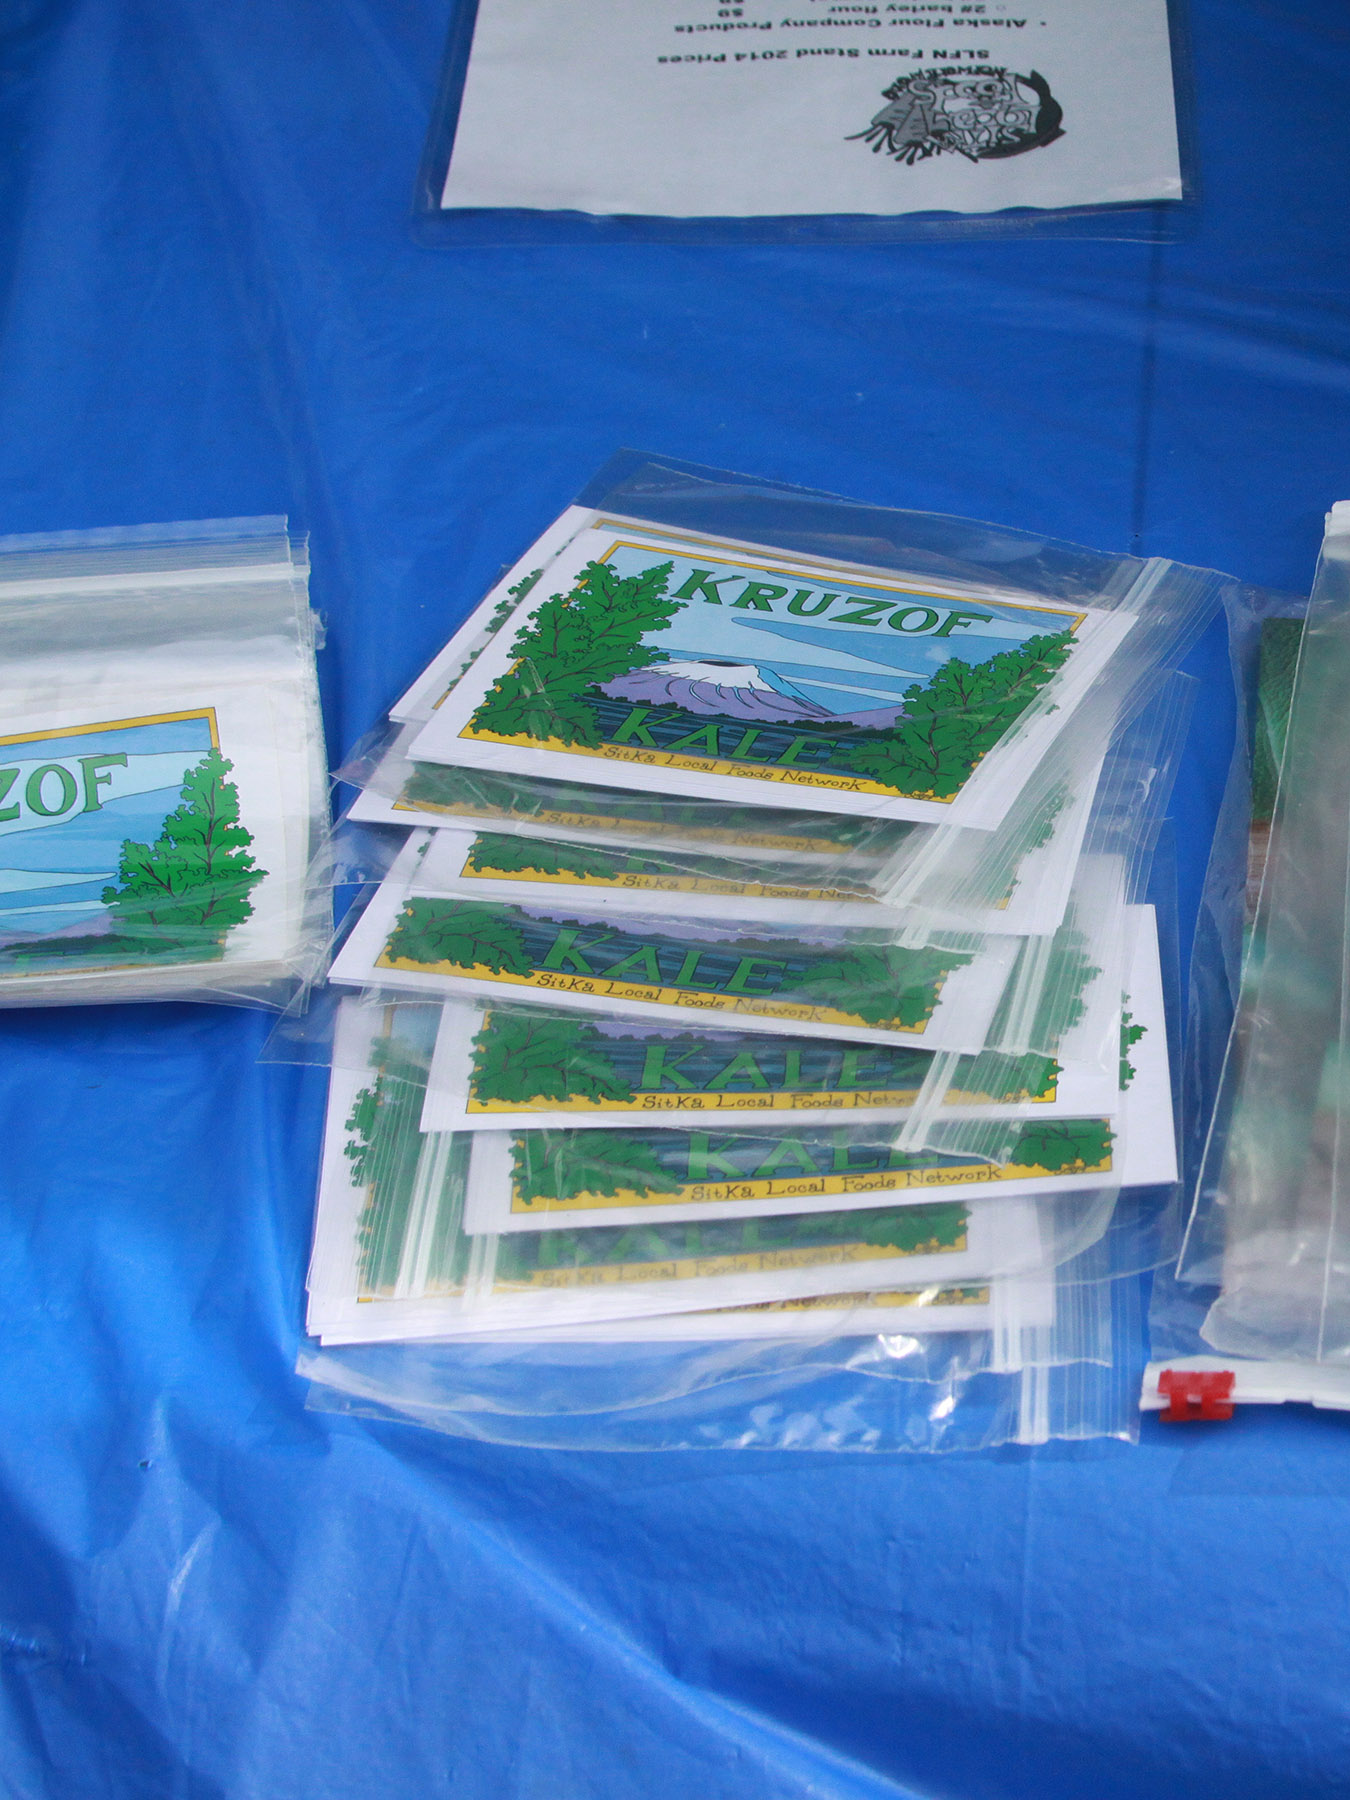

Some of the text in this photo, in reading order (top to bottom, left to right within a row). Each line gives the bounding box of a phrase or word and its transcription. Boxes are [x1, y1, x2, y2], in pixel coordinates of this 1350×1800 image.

[828, 5, 878, 14] flour
[886, 4, 952, 14] barley
[675, 17, 1027, 33] Alaska Flour Company Products
[657, 48, 990, 64] SLFN Farm Stand 2014 Prices
[670, 568, 993, 639] KRUZOF
[610, 706, 839, 770] KALE
[664, 753, 716, 772] Local
[727, 762, 774, 781] Foods
[690, 879, 746, 895] Local
[540, 928, 789, 995] KALE
[604, 981, 661, 1001] Local
[672, 990, 726, 1010] Foods
[639, 1045, 894, 1092] KALE
[715, 1093, 775, 1109] Local
[790, 1091, 844, 1108] Foods
[766, 1178, 826, 1196] Local
[842, 1174, 897, 1192] Foods
[618, 1262, 677, 1280] Local
